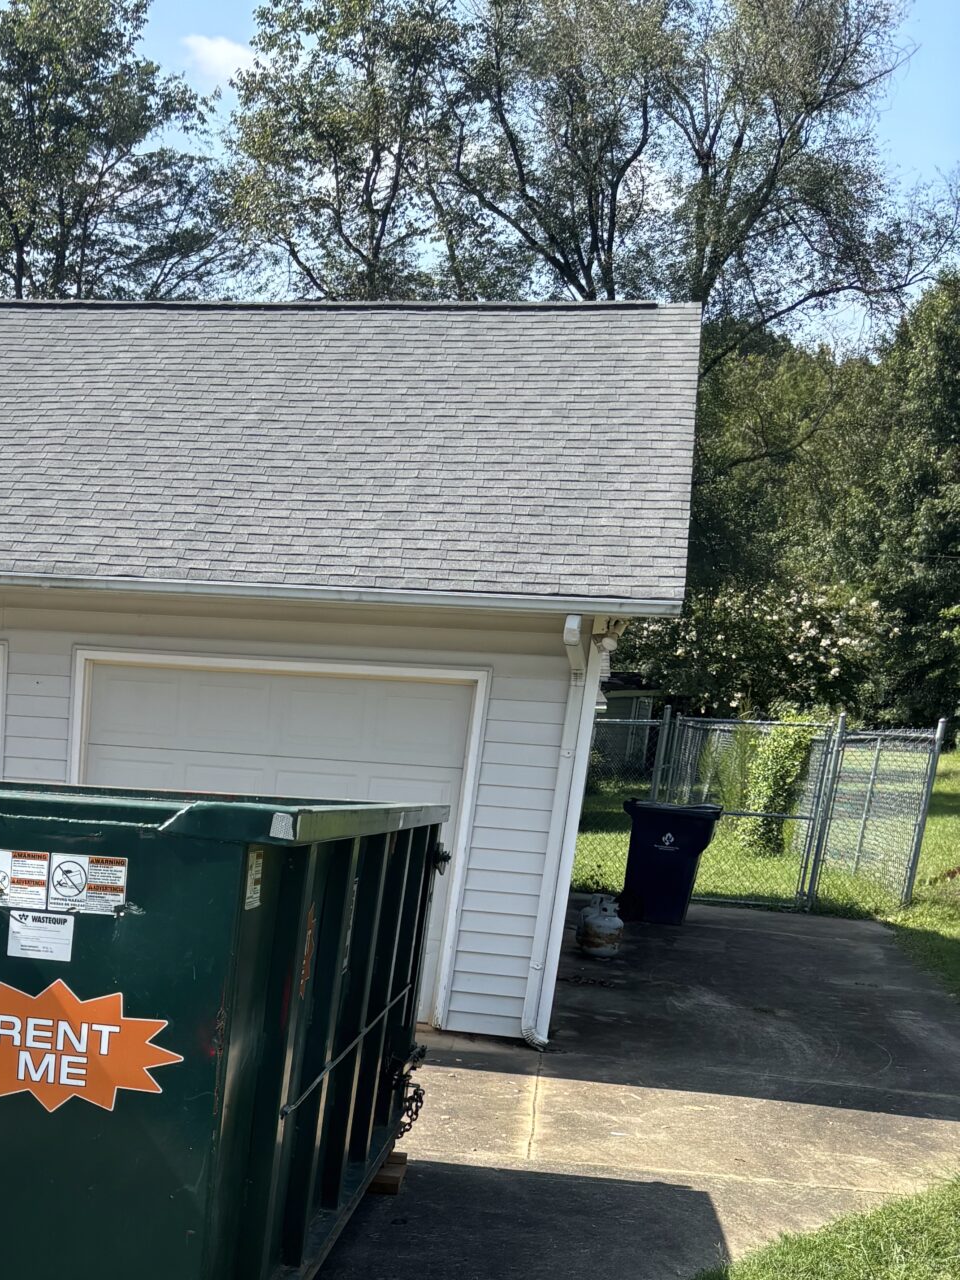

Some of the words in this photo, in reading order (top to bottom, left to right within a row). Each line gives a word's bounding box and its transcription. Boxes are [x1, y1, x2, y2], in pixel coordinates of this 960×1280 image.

[95, 858, 125, 866] WARNING
[31, 915, 68, 926] WASTEQUIP
[16, 1049, 89, 1087] ME
